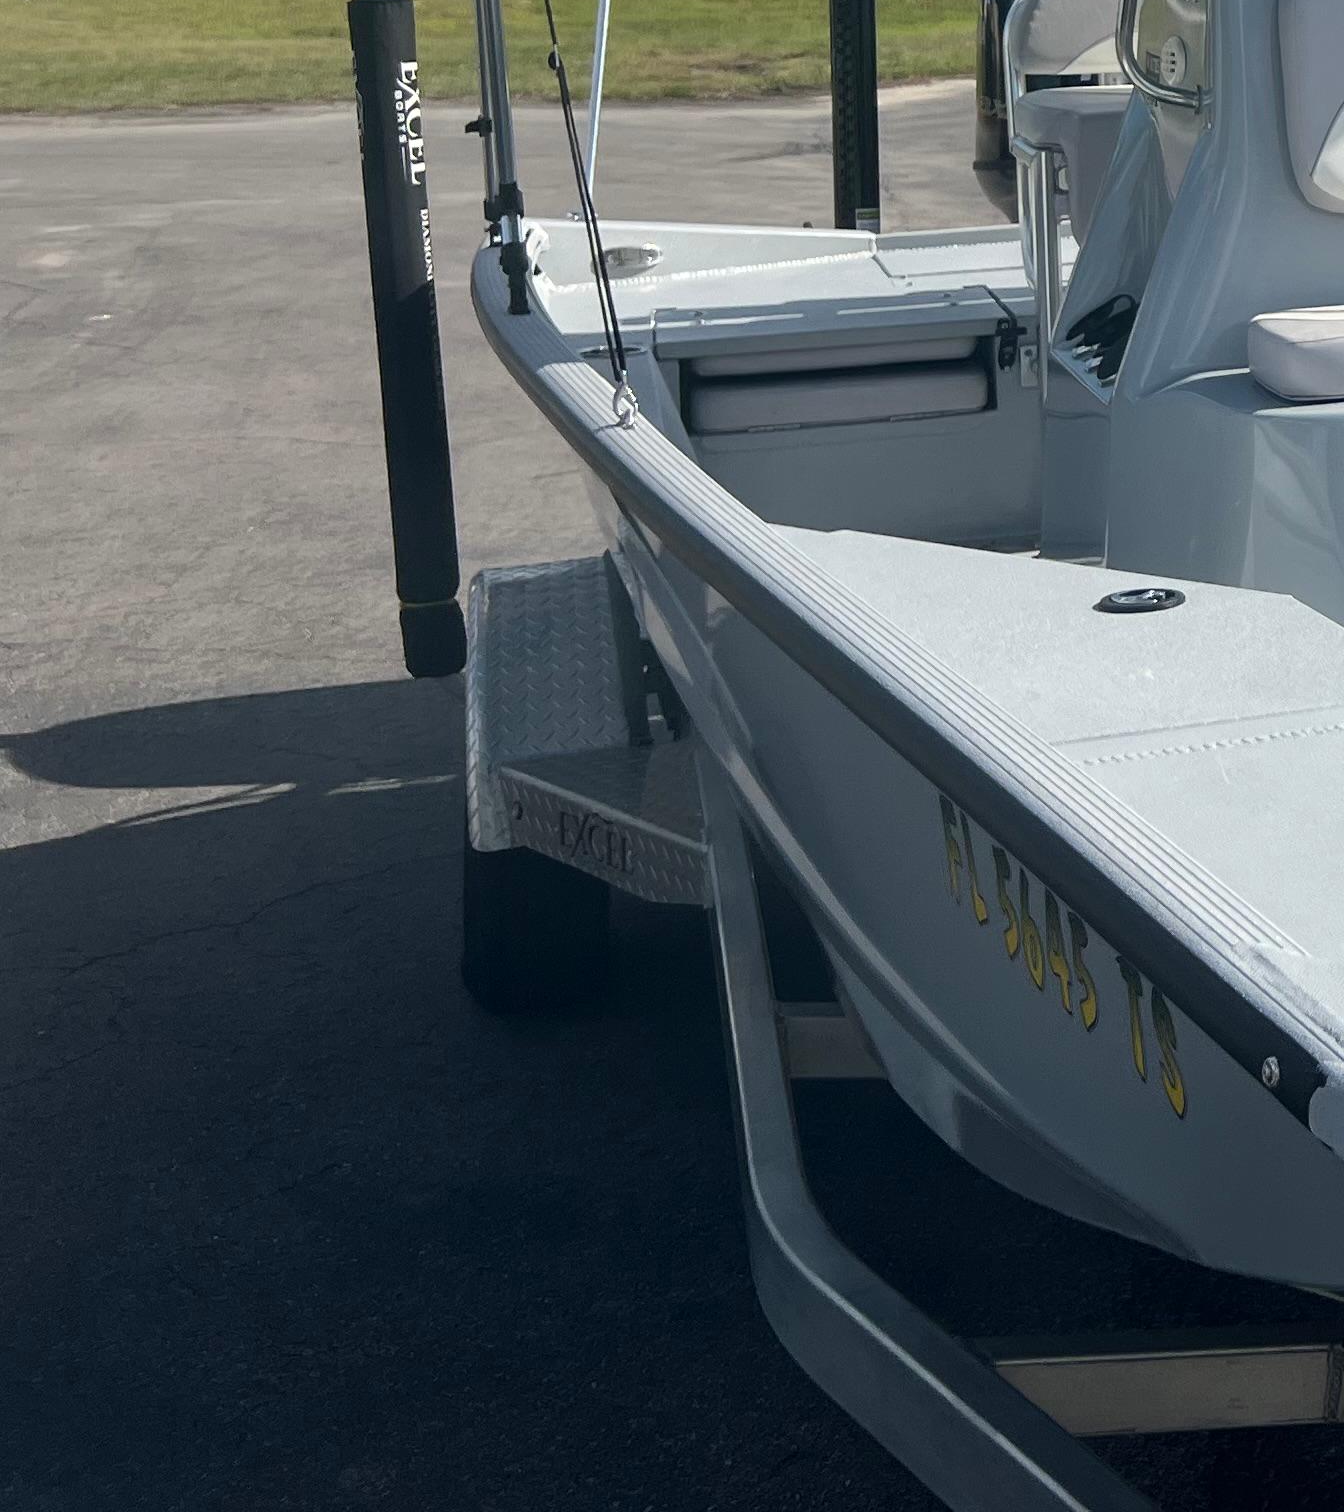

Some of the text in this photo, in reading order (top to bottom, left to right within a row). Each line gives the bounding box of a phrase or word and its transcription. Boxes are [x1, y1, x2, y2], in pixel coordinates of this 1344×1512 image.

[394, 89, 408, 144] BOATS
[396, 60, 426, 185] EXCEL
[939, 793, 988, 925] FL
[1115, 954, 1187, 1120] TS
